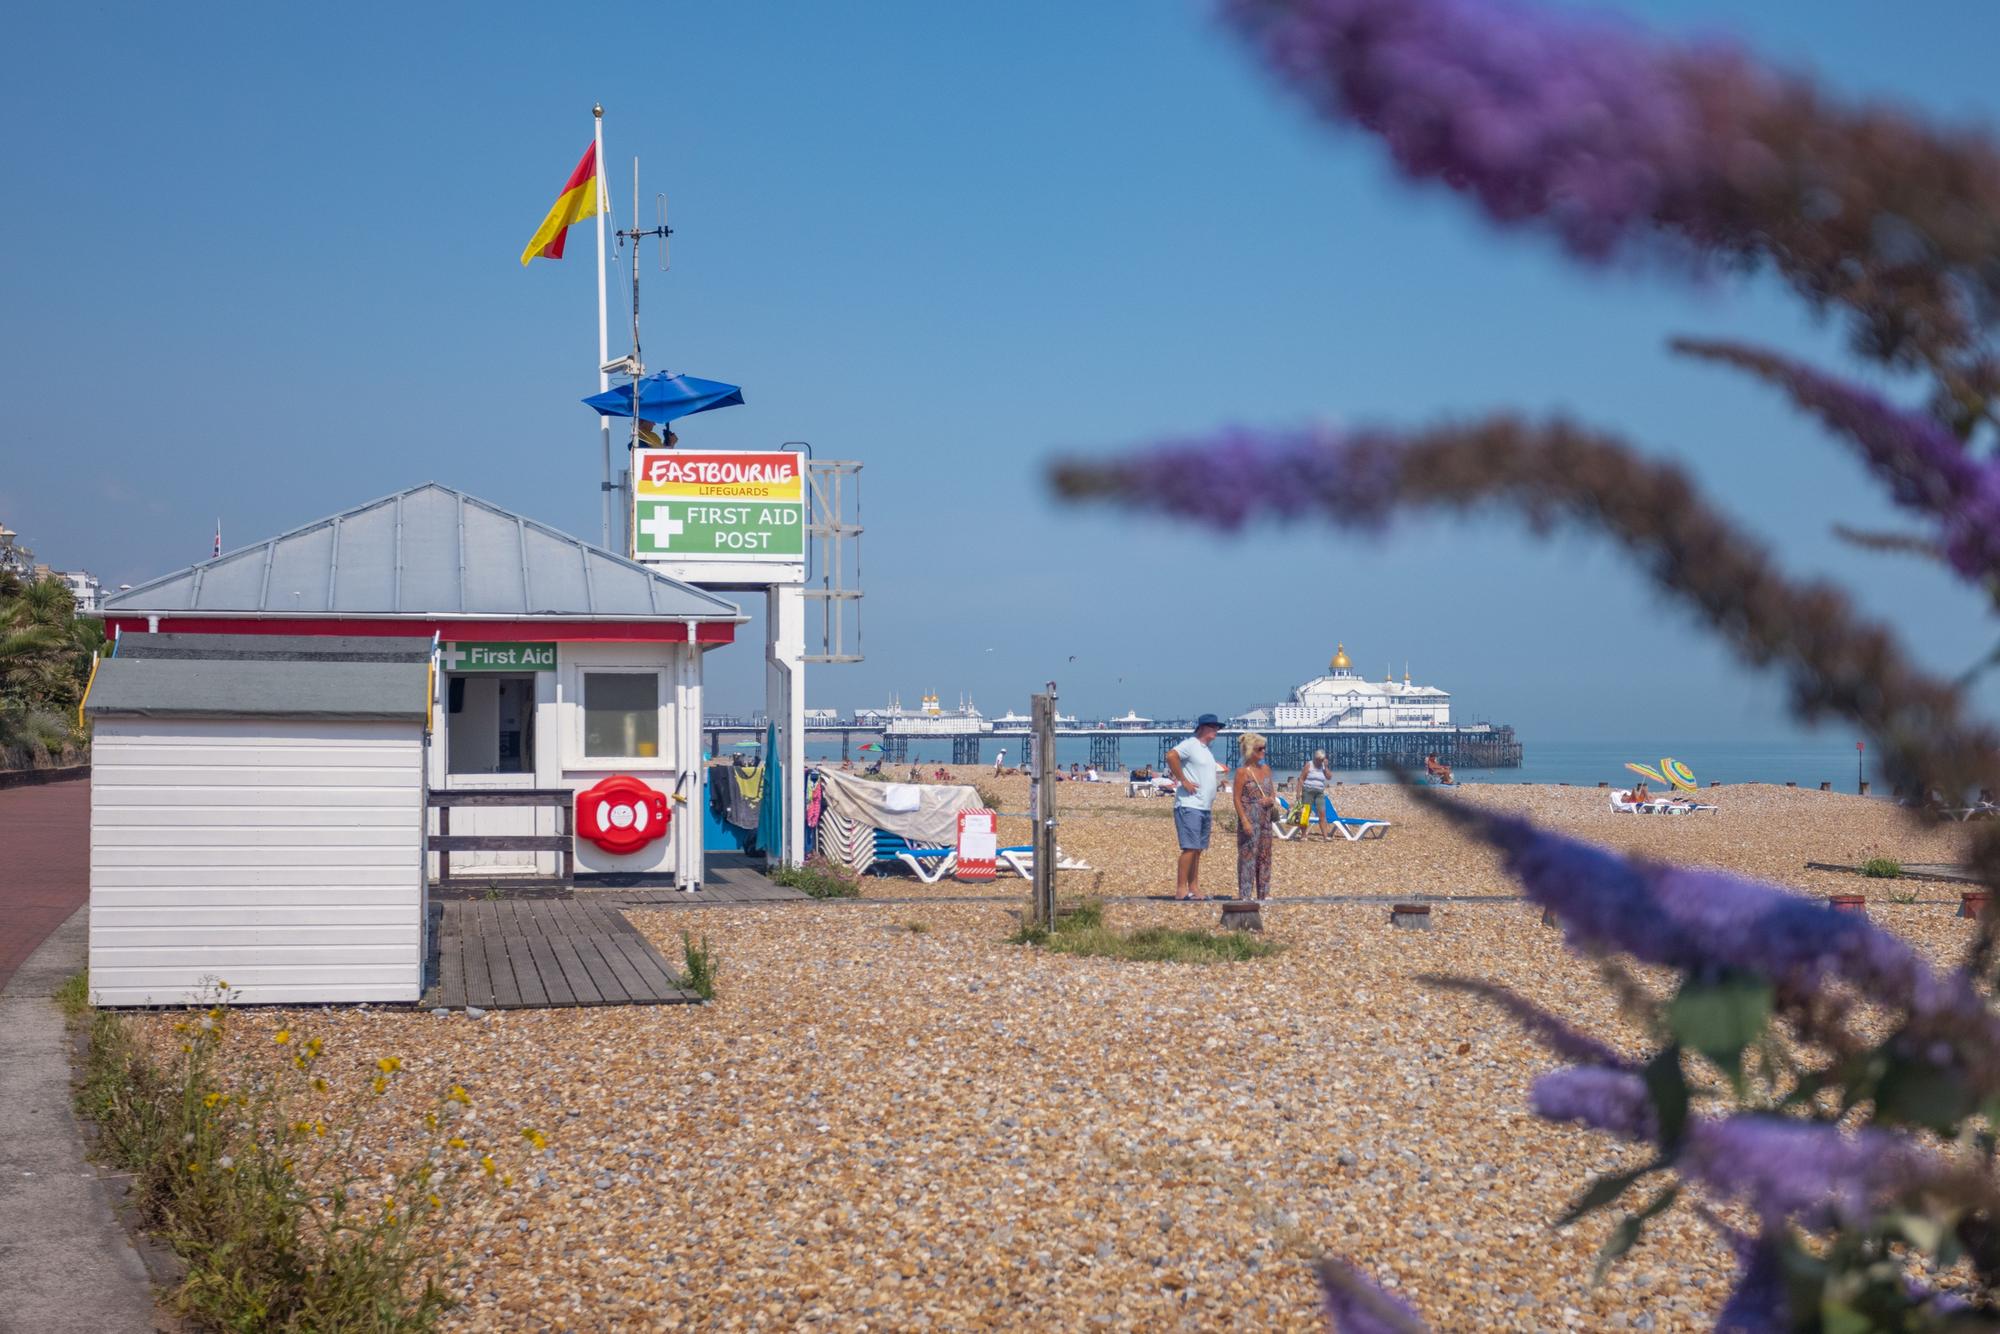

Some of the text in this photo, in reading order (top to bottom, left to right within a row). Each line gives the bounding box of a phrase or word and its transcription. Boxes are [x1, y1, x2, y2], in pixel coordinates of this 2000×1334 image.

[649, 460, 792, 487] EASTBOURNE
[699, 486, 769, 497] LIFEGUARDS
[687, 507, 798, 525] FIRST AID
[715, 532, 772, 549] POST
[471, 648, 553, 664] First Aid
